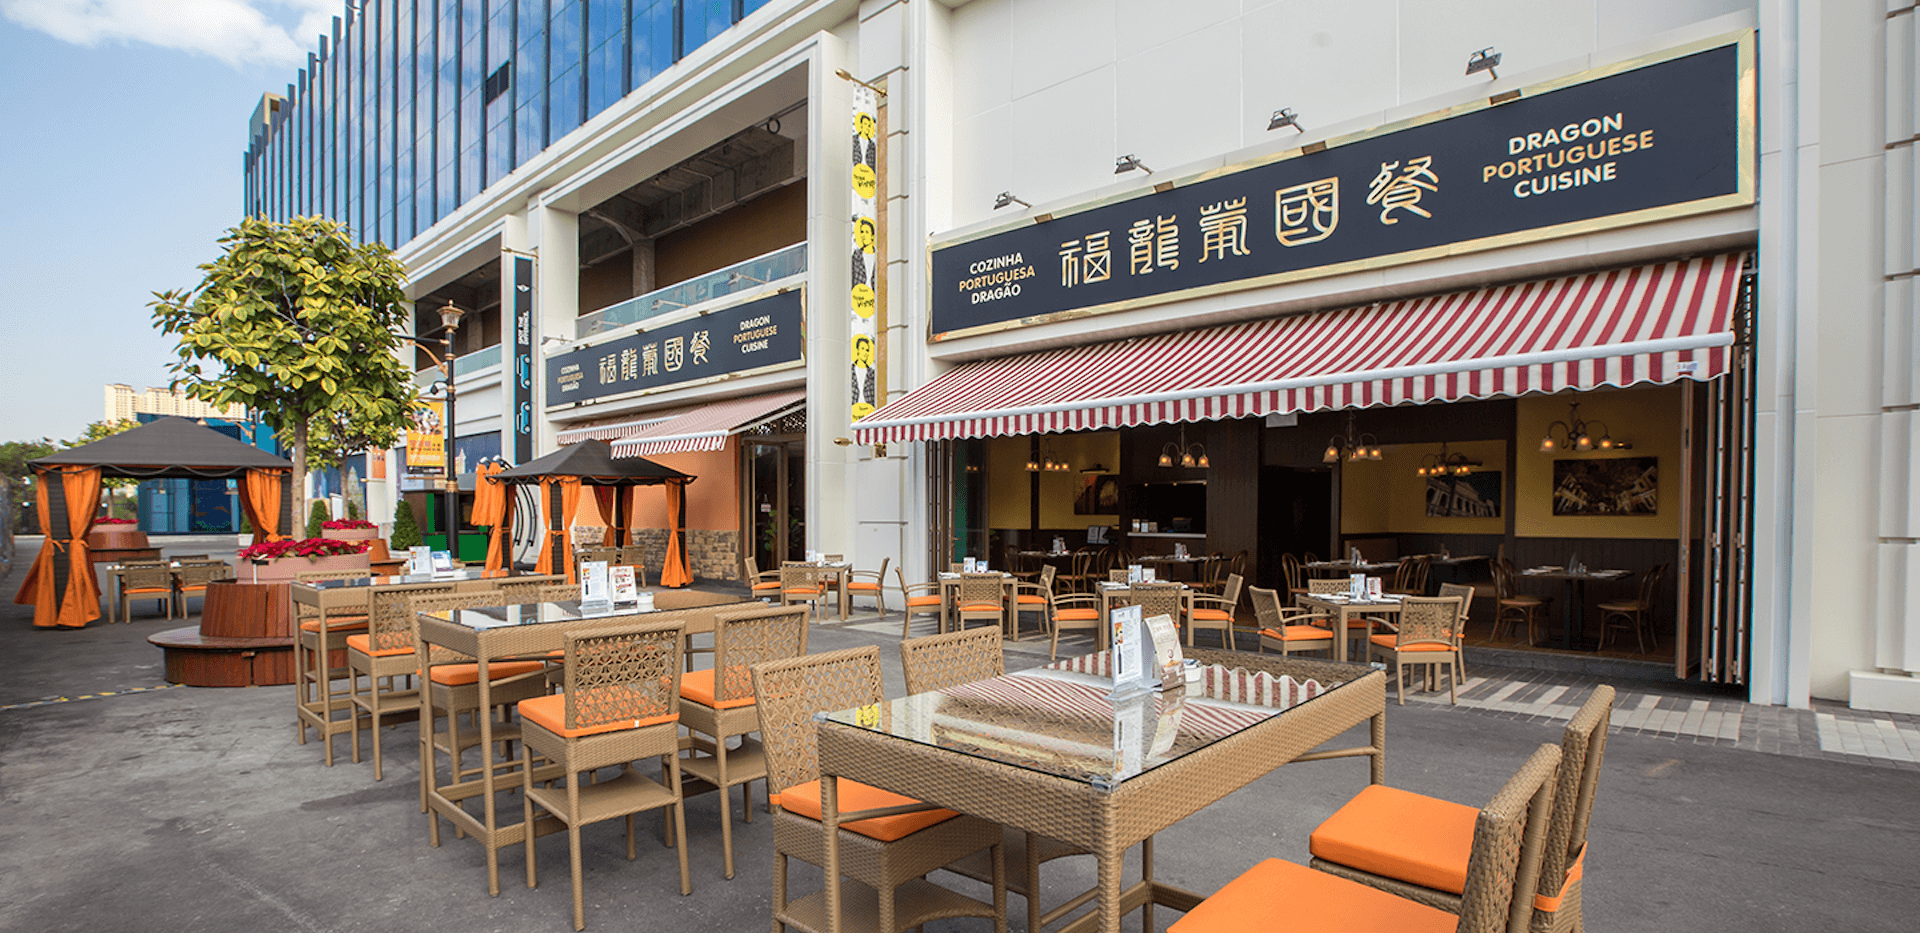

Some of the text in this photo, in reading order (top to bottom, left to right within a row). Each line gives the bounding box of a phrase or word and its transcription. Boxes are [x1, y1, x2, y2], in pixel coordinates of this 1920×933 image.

[1508, 112, 1623, 156] DRAGON
[1483, 129, 1655, 184] PORTUGUESE
[1513, 161, 1617, 198] CUISINE
[969, 252, 1023, 275] COZINHA
[958, 264, 1036, 292] PORTUGUESA
[971, 282, 1021, 305] DRAGÃO
[732, 324, 777, 344] PORTUGUESE
[739, 315, 771, 331] DRAGON
[741, 338, 769, 354] CUISINE
